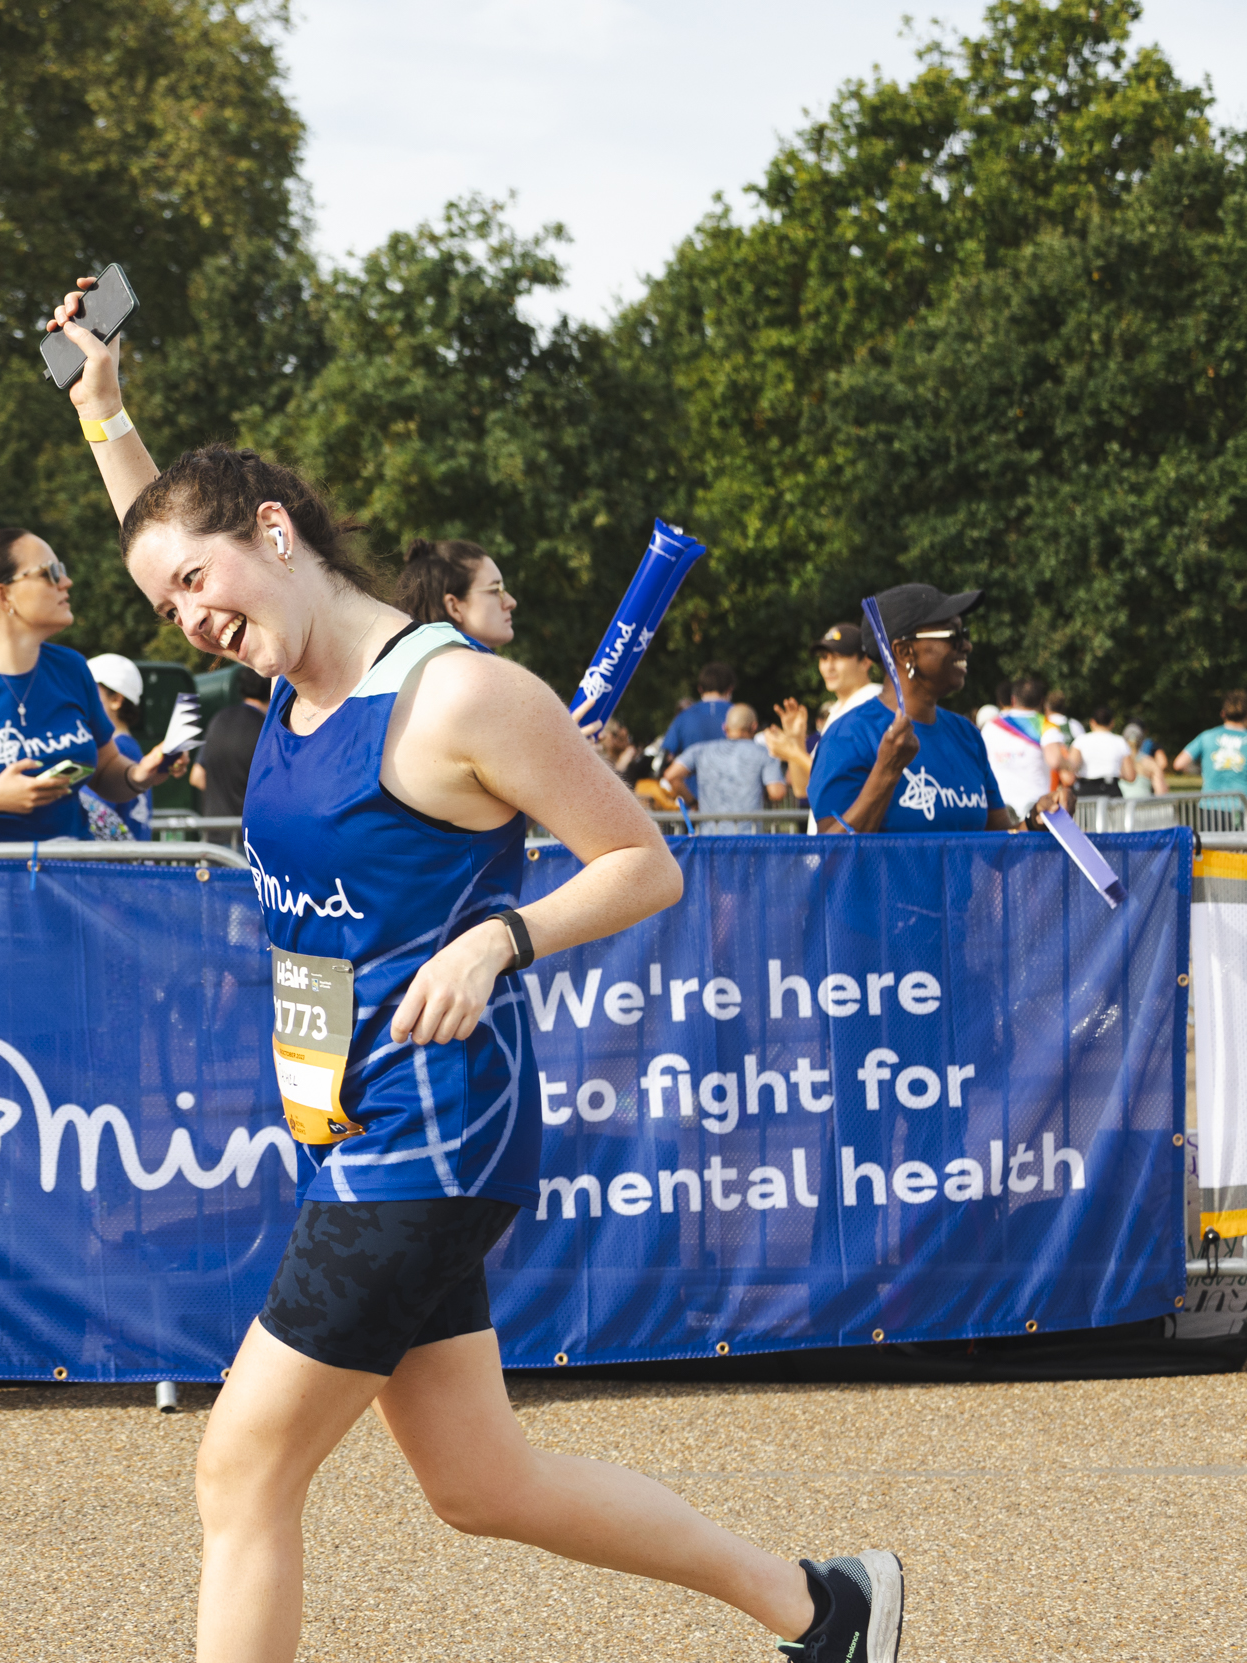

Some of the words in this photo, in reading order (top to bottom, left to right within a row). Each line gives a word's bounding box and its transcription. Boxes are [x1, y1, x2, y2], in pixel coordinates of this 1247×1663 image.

[261, 876, 365, 920] mind
[524, 963, 742, 1032] We're
[768, 959, 941, 1018] here
[539, 1071, 617, 1126] to
[640, 1053, 835, 1134] fight
[857, 1048, 975, 1110] for
[39, 1090, 298, 1193] min
[536, 1147, 819, 1220] mental
[841, 1132, 1086, 1207] health
[846, 1631, 860, 1659] balance
